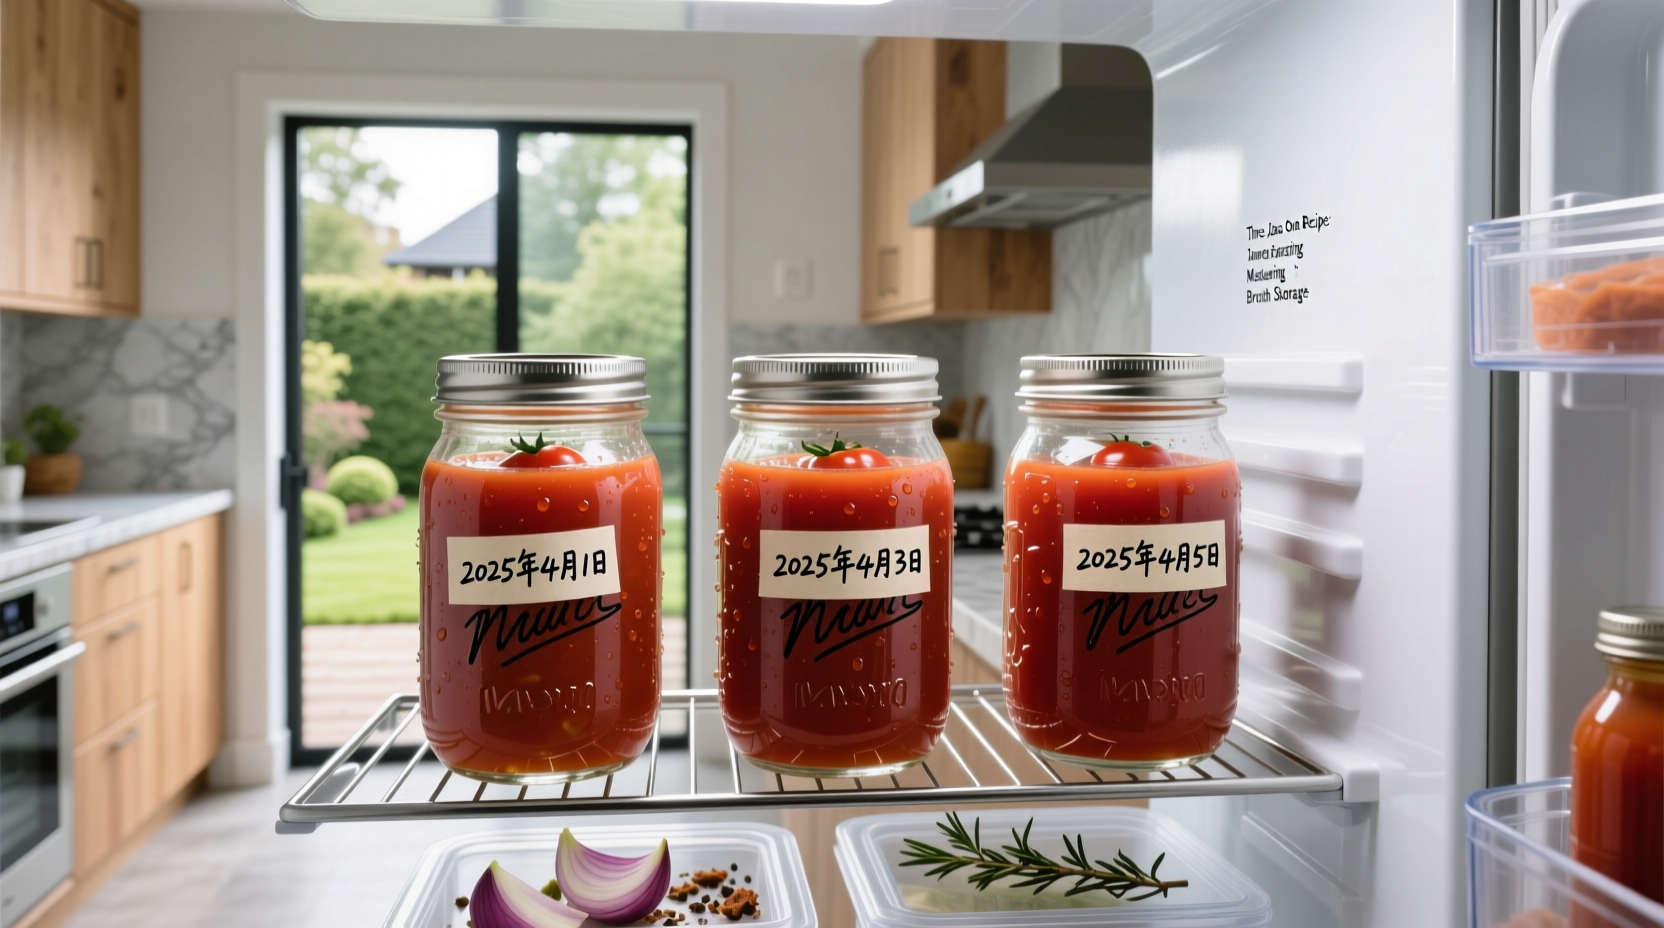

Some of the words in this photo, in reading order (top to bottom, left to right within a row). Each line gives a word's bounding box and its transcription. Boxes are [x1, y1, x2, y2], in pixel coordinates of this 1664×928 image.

[460, 549, 606, 587] 2025年4月1日
[773, 545, 921, 584] 2025年4月3日
[1076, 540, 1219, 577] 2025年4月5日
